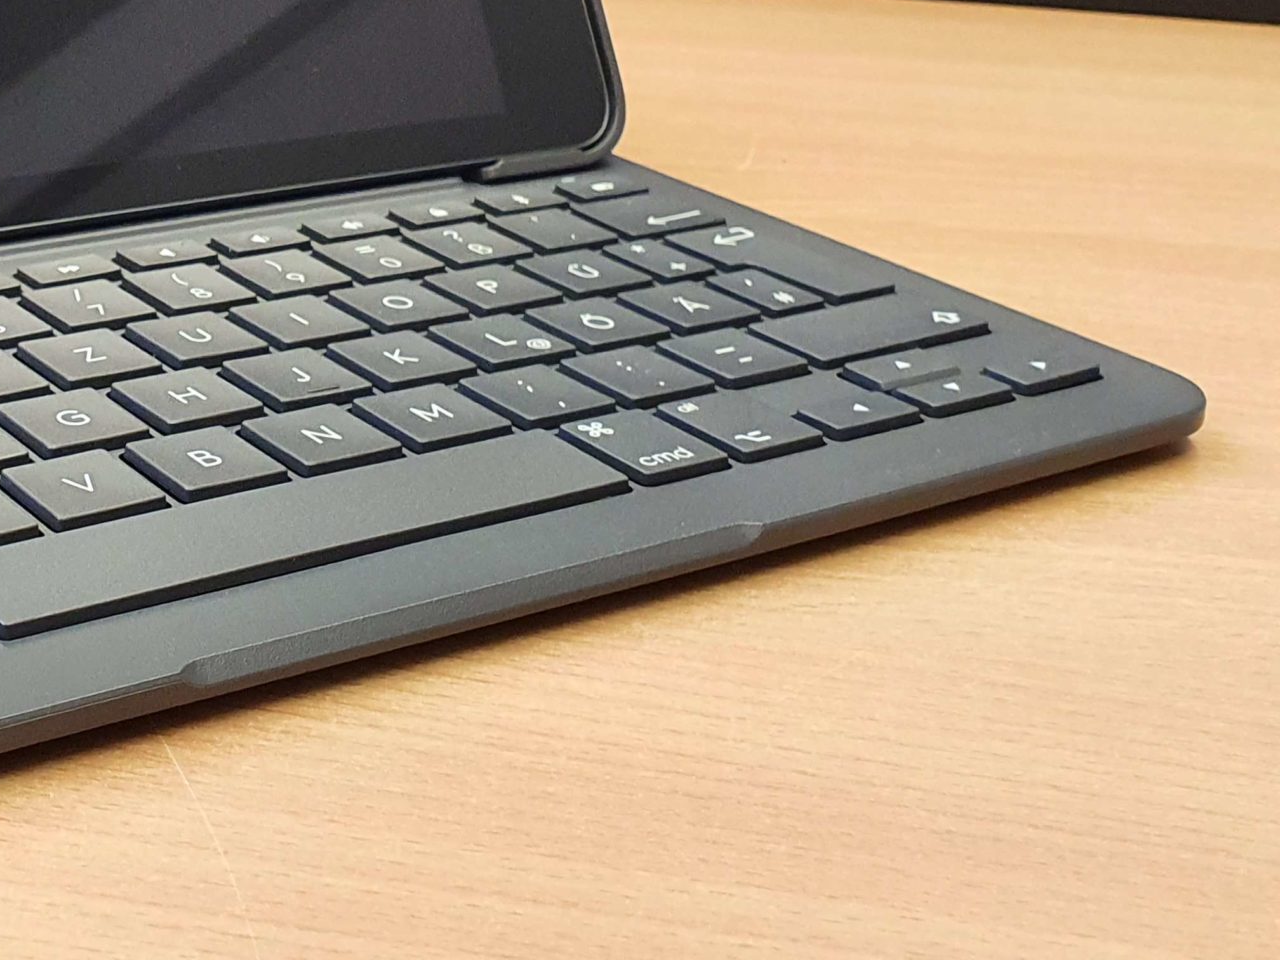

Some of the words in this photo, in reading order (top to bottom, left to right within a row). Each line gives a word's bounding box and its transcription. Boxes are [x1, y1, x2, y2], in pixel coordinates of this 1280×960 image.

[379, 257, 402, 268] 0
[285, 272, 305, 283] 9
[189, 287, 213, 299] 8
[476, 279, 498, 294] P
[86, 303, 105, 315] 7
[382, 295, 414, 309] O
[178, 327, 212, 343] U
[484, 332, 518, 347] L
[72, 346, 107, 363] Z
[383, 348, 419, 365] K
[291, 366, 311, 383] J
[167, 386, 207, 404] H
[56, 409, 91, 426] G
[409, 403, 454, 423] M
[300, 424, 343, 444] N
[186, 450, 223, 468] B
[638, 445, 696, 468] cmd
[61, 473, 94, 492] V
